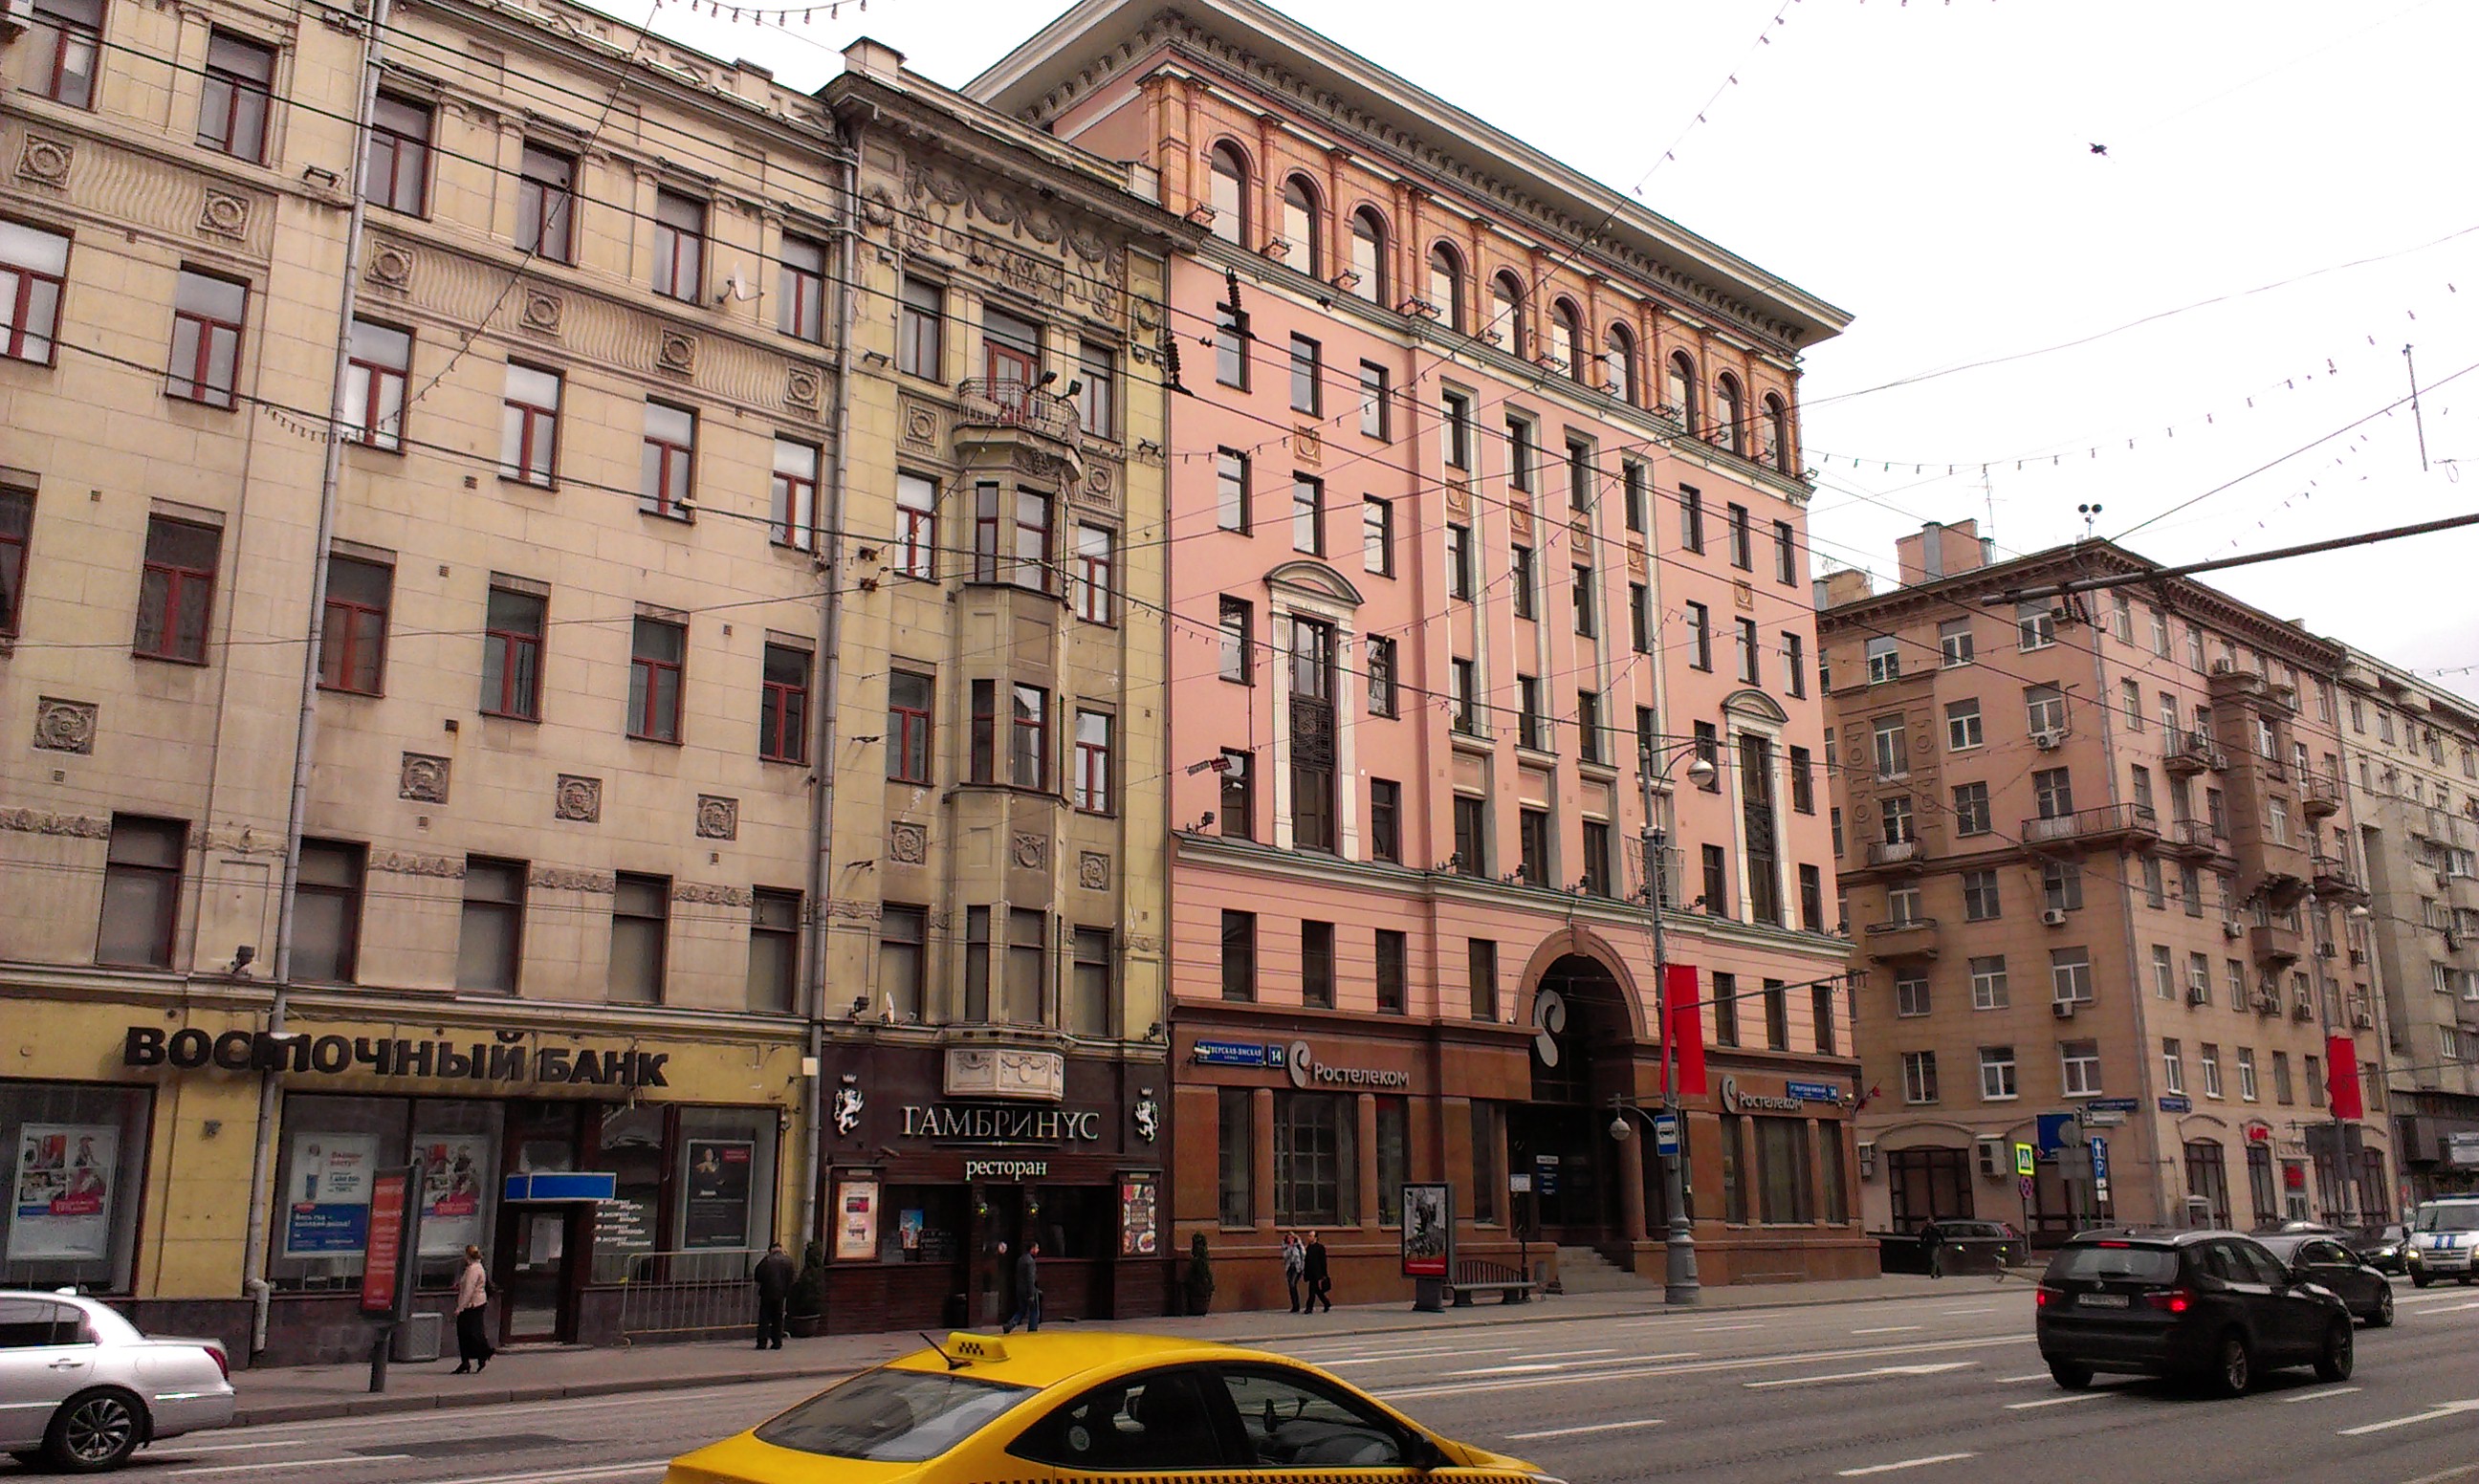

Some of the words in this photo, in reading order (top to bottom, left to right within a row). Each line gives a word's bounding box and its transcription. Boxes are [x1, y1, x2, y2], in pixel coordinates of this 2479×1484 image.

[124, 1027, 526, 1081] ВОСТОЧНЫЙ
[539, 1048, 669, 1087] БАНК
[1271, 1050, 1282, 1062] 14
[1313, 1061, 1410, 1085] Ростелеком
[1739, 1091, 1804, 1109] Ростелеком
[900, 1106, 1100, 1140] ГАМБРИНУС
[965, 1160, 1047, 1182] ресторан
